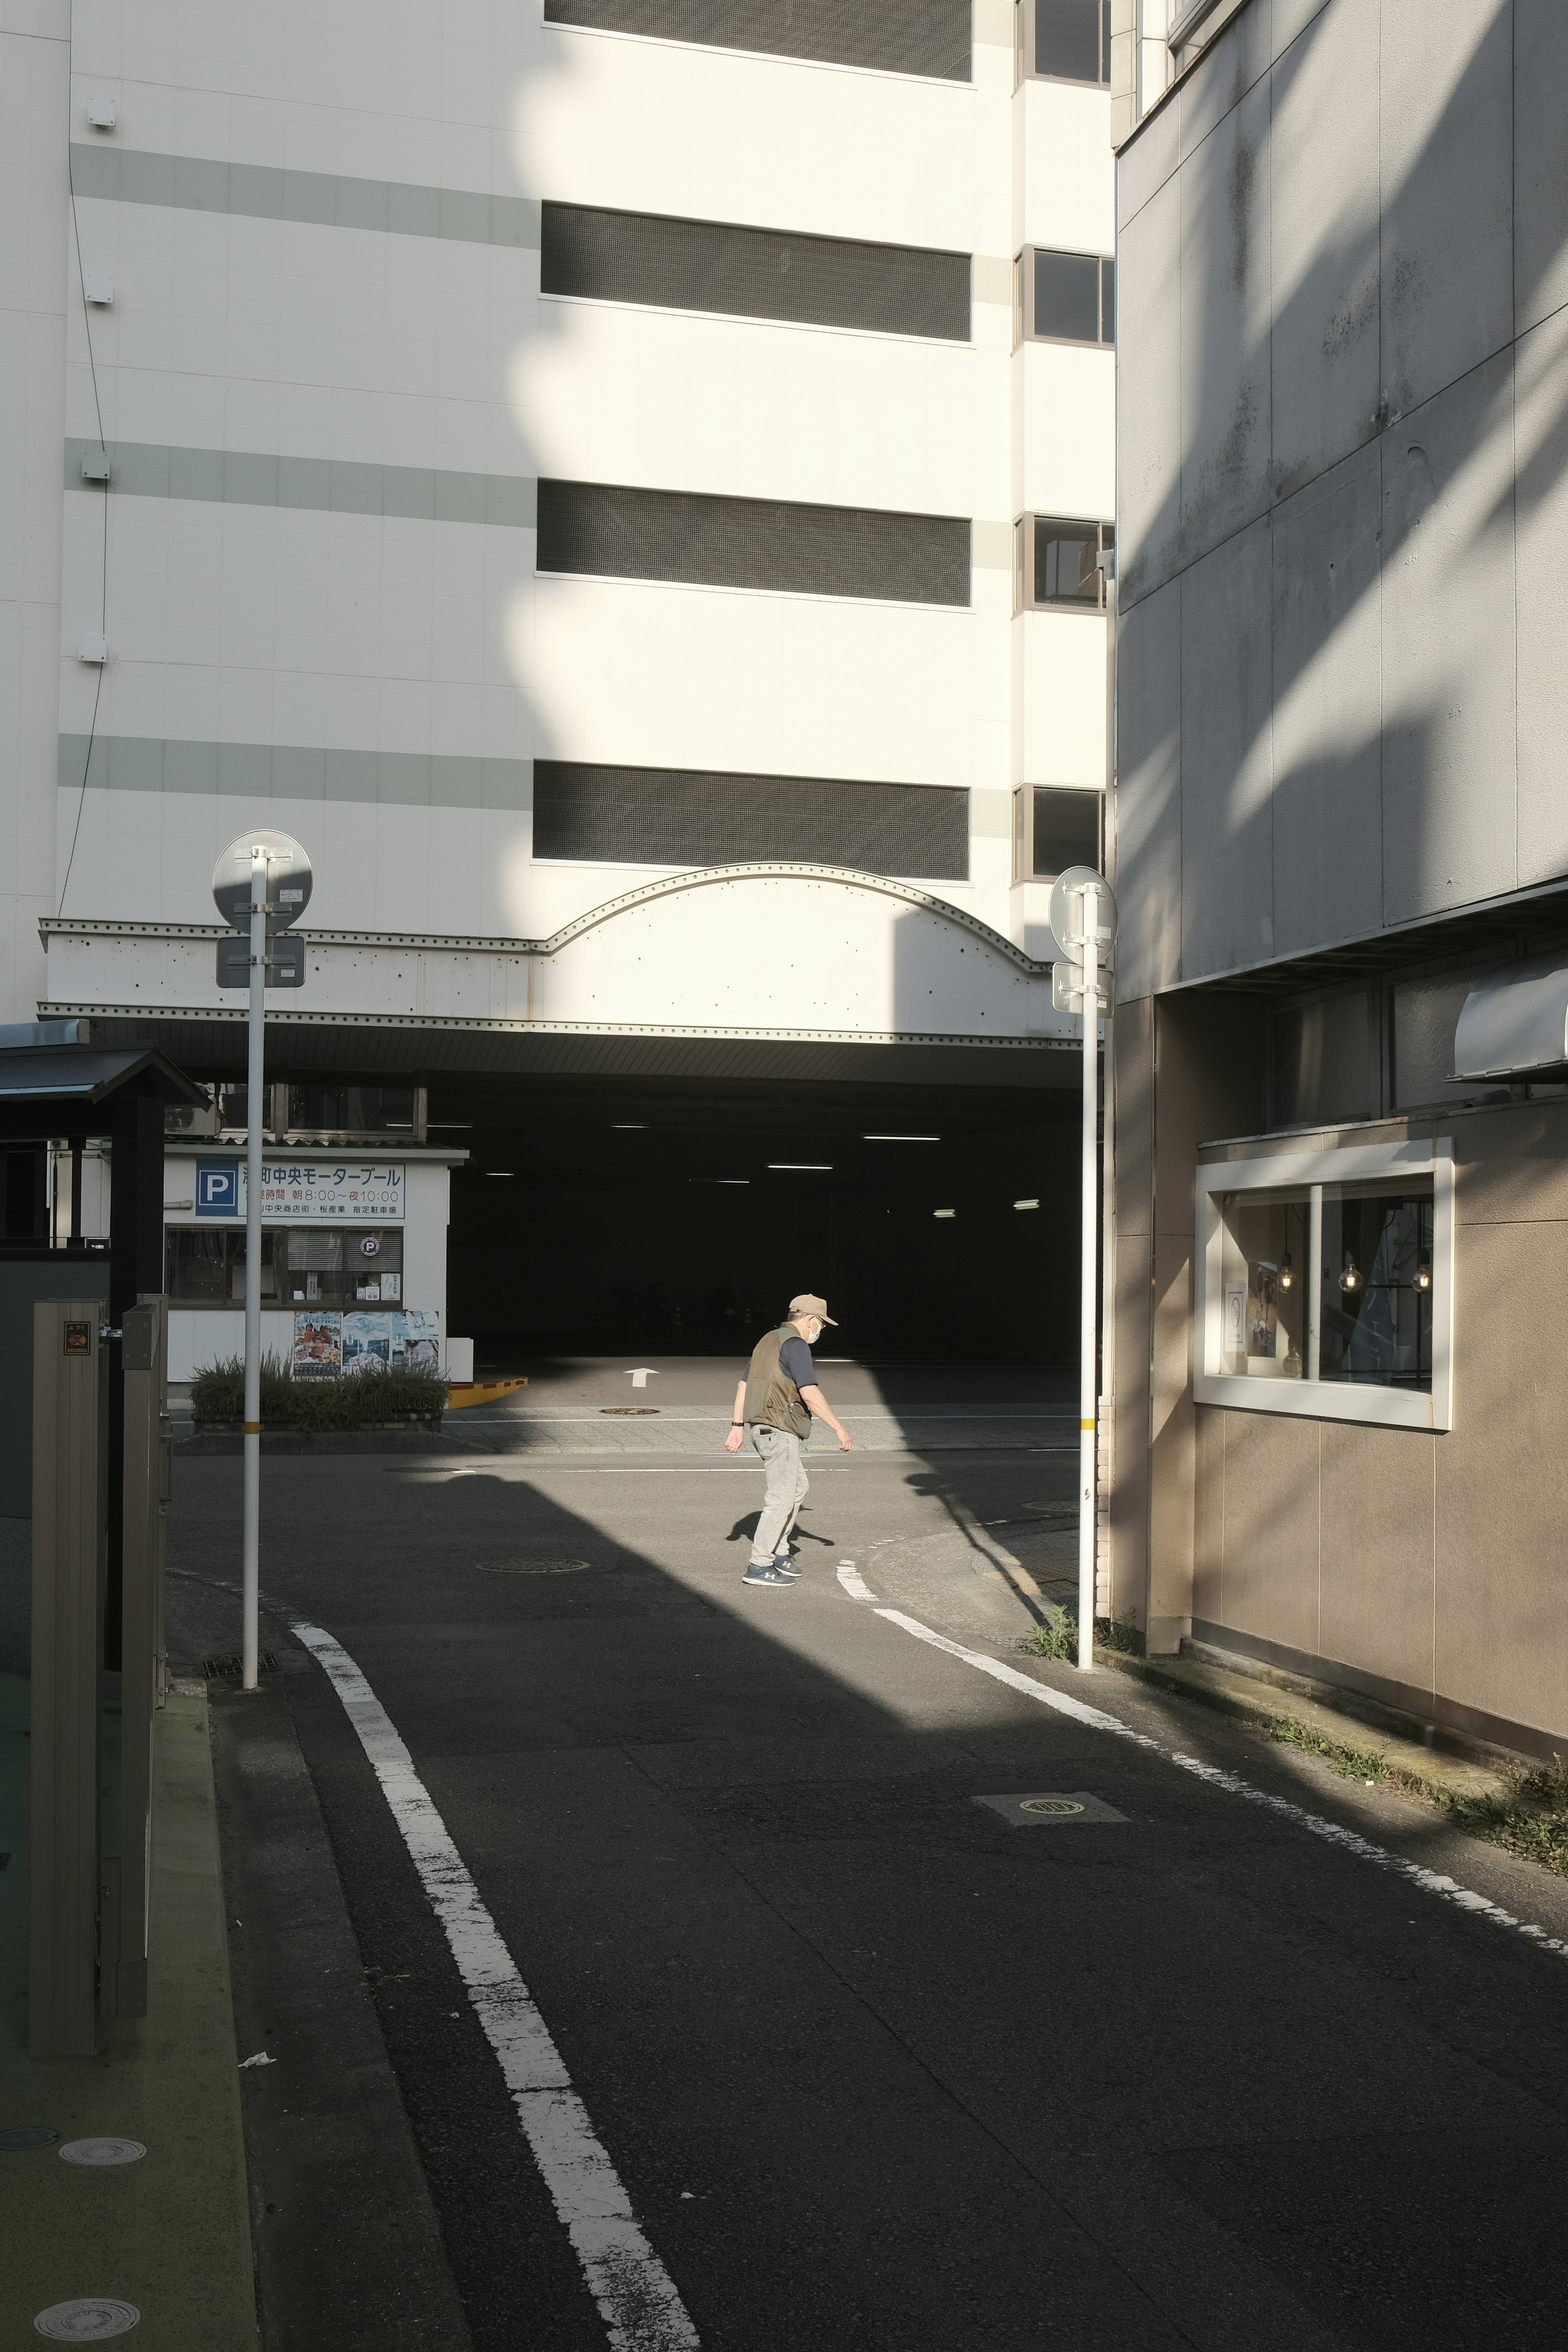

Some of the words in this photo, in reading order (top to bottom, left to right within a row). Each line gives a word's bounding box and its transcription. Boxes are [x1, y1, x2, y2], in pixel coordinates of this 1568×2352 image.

[242, 1166, 401, 1186] 町中央モータープール
[207, 1175, 229, 1201] P
[245, 1189, 285, 1200] 時間
[353, 1206, 396, 1214] 指定駐車場
[366, 1242, 375, 1251] P
